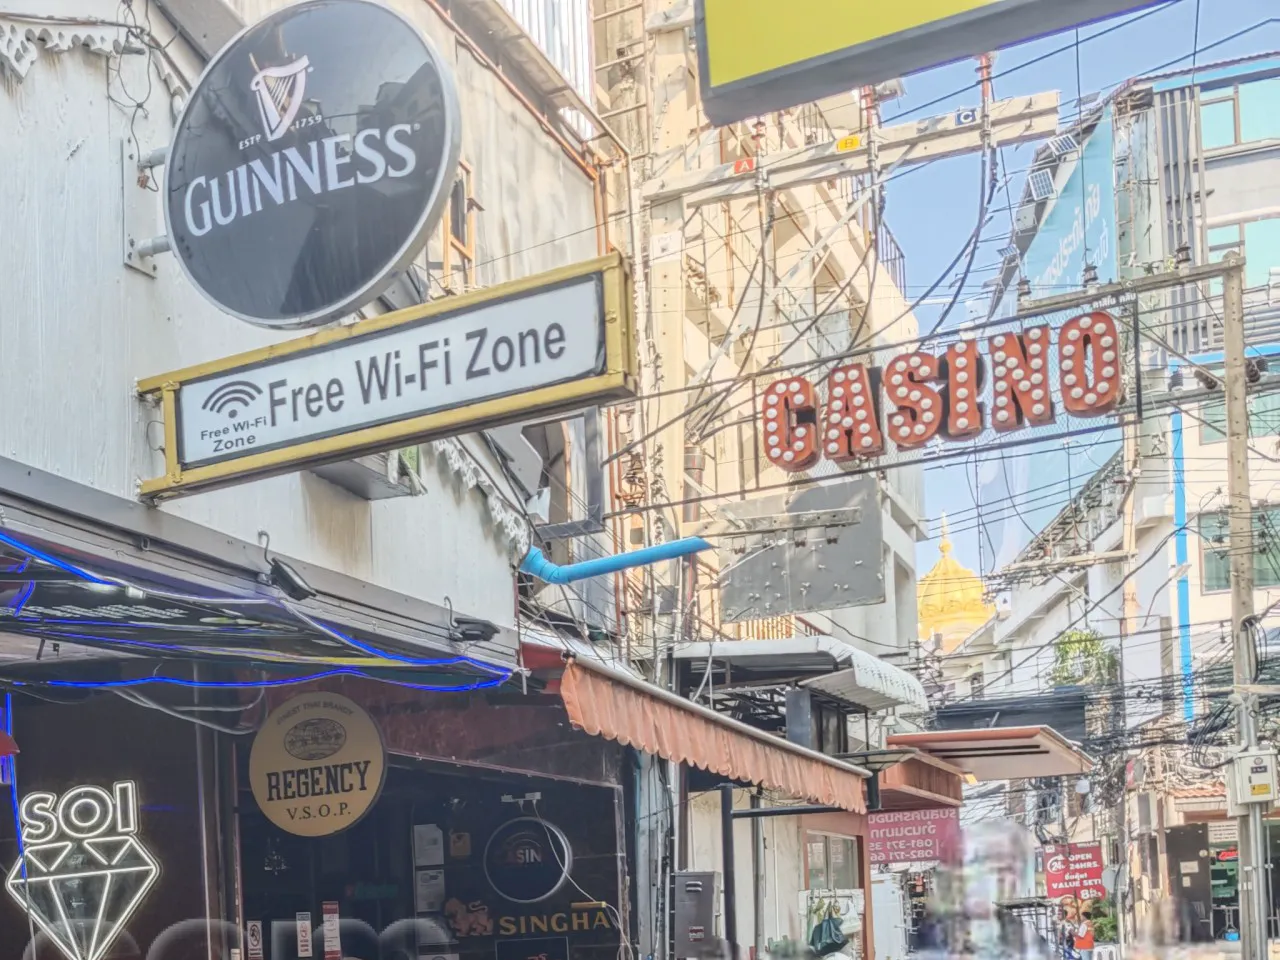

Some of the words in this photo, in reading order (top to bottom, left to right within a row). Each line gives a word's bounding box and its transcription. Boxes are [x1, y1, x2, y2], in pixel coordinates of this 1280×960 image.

[295, 114, 323, 129] 1759
[959, 111, 974, 123] C
[184, 122, 417, 237] GUINNESS
[269, 378, 344, 428] Free
[355, 336, 452, 407] Wi-Fi
[465, 321, 566, 381] Zone
[762, 310, 1124, 473] CASINO
[200, 424, 229, 442] Free
[212, 432, 257, 453] Zone
[266, 760, 371, 802] REGENCY
[20, 780, 138, 843] SOI
[286, 802, 352, 821] V.S.O.P.
[1068, 853, 1092, 862] OPEN
[1051, 880, 1080, 889] VALUE
[498, 910, 611, 936] SINGHA
